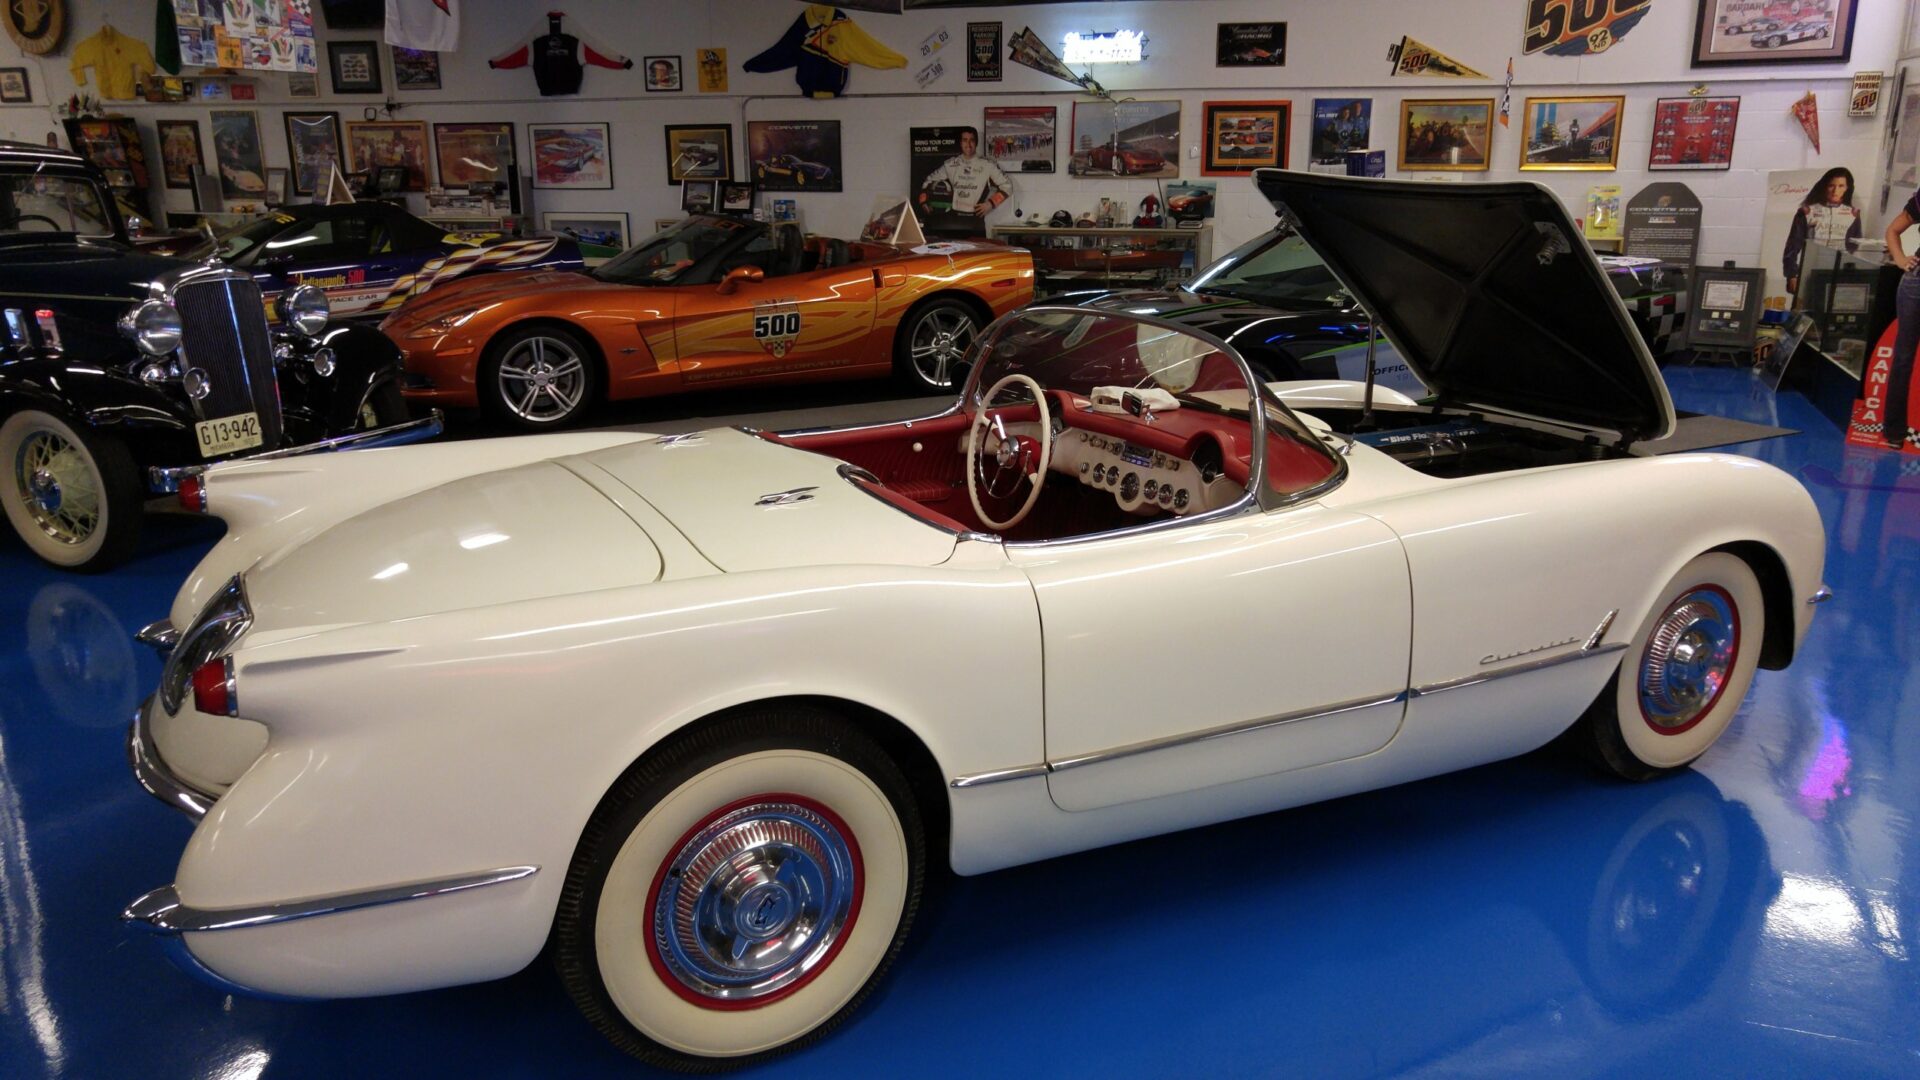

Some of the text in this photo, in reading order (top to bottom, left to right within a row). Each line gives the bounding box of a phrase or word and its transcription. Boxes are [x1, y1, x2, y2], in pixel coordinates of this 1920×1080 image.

[920, 31, 949, 56] 20 03
[1589, 29, 1609, 45] 92
[975, 45, 993, 54] 500
[1400, 53, 1431, 70] 500
[1852, 91, 1878, 110] 500
[295, 272, 347, 288] Indianapolis
[348, 269, 366, 284] 500
[755, 312, 801, 338] 500
[1373, 364, 1409, 376] OFFIC
[1862, 346, 1893, 422] DANICA
[1390, 433, 1411, 443] Blue
